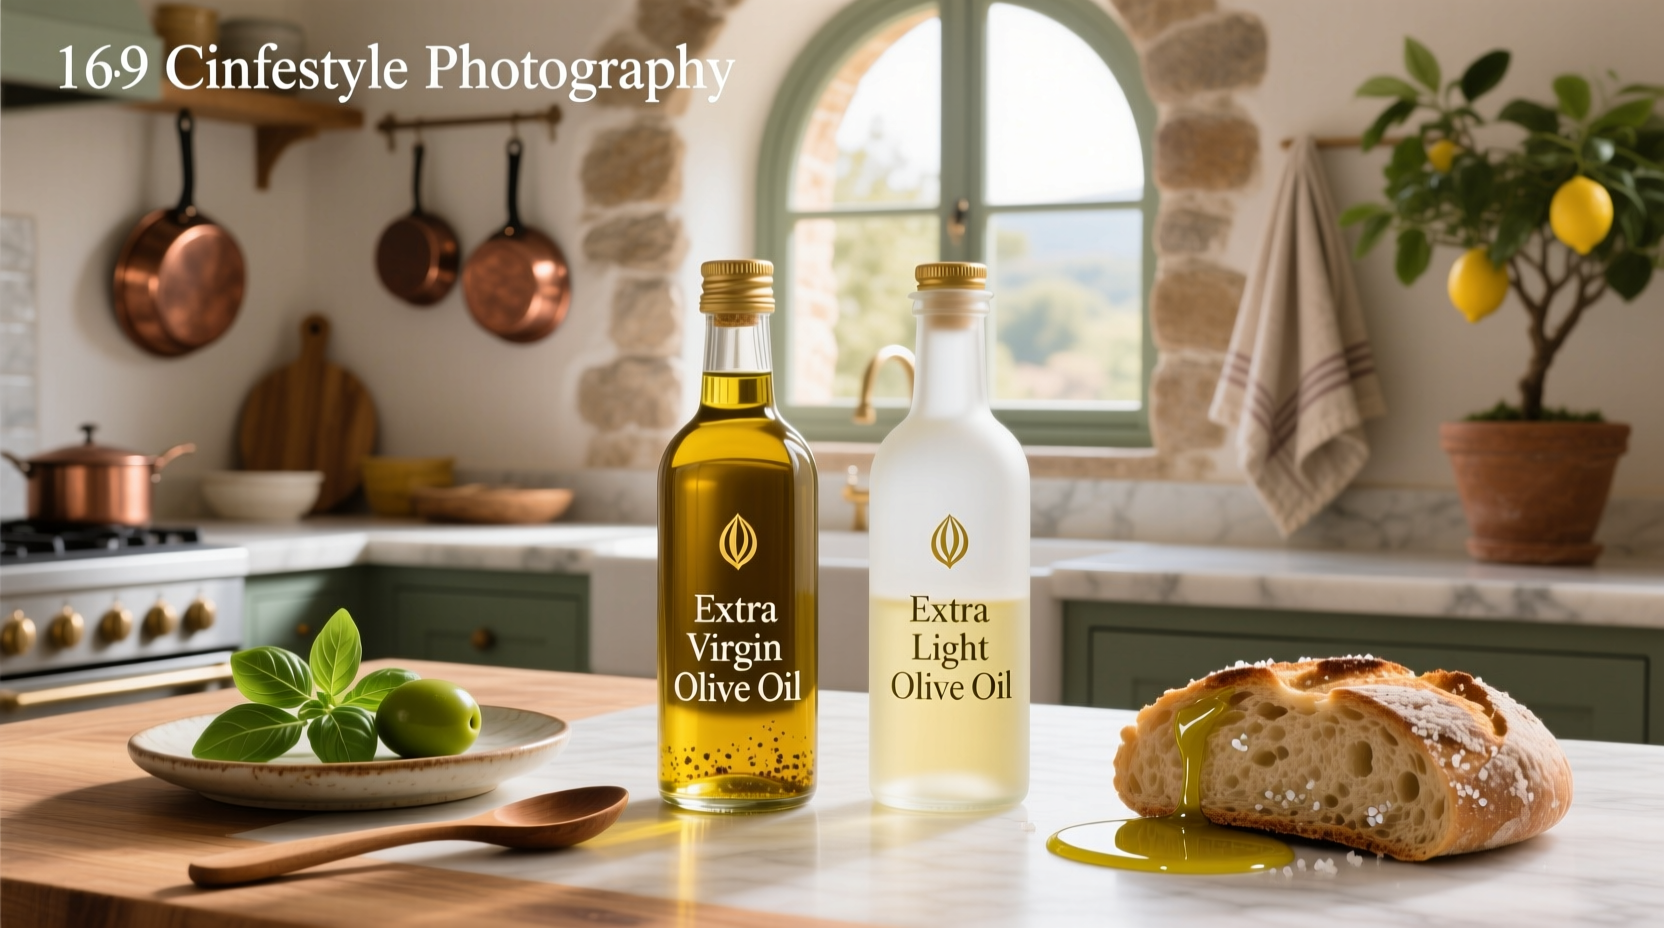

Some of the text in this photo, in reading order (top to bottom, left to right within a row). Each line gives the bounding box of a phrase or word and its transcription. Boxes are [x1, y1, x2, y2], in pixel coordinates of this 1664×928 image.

[694, 594, 778, 623] Extra
[909, 595, 990, 623] Extra
[686, 632, 783, 671] Virgin
[912, 633, 989, 670] Light
[674, 670, 801, 703] Olive Oil
[891, 669, 1012, 700] Olive Oil
